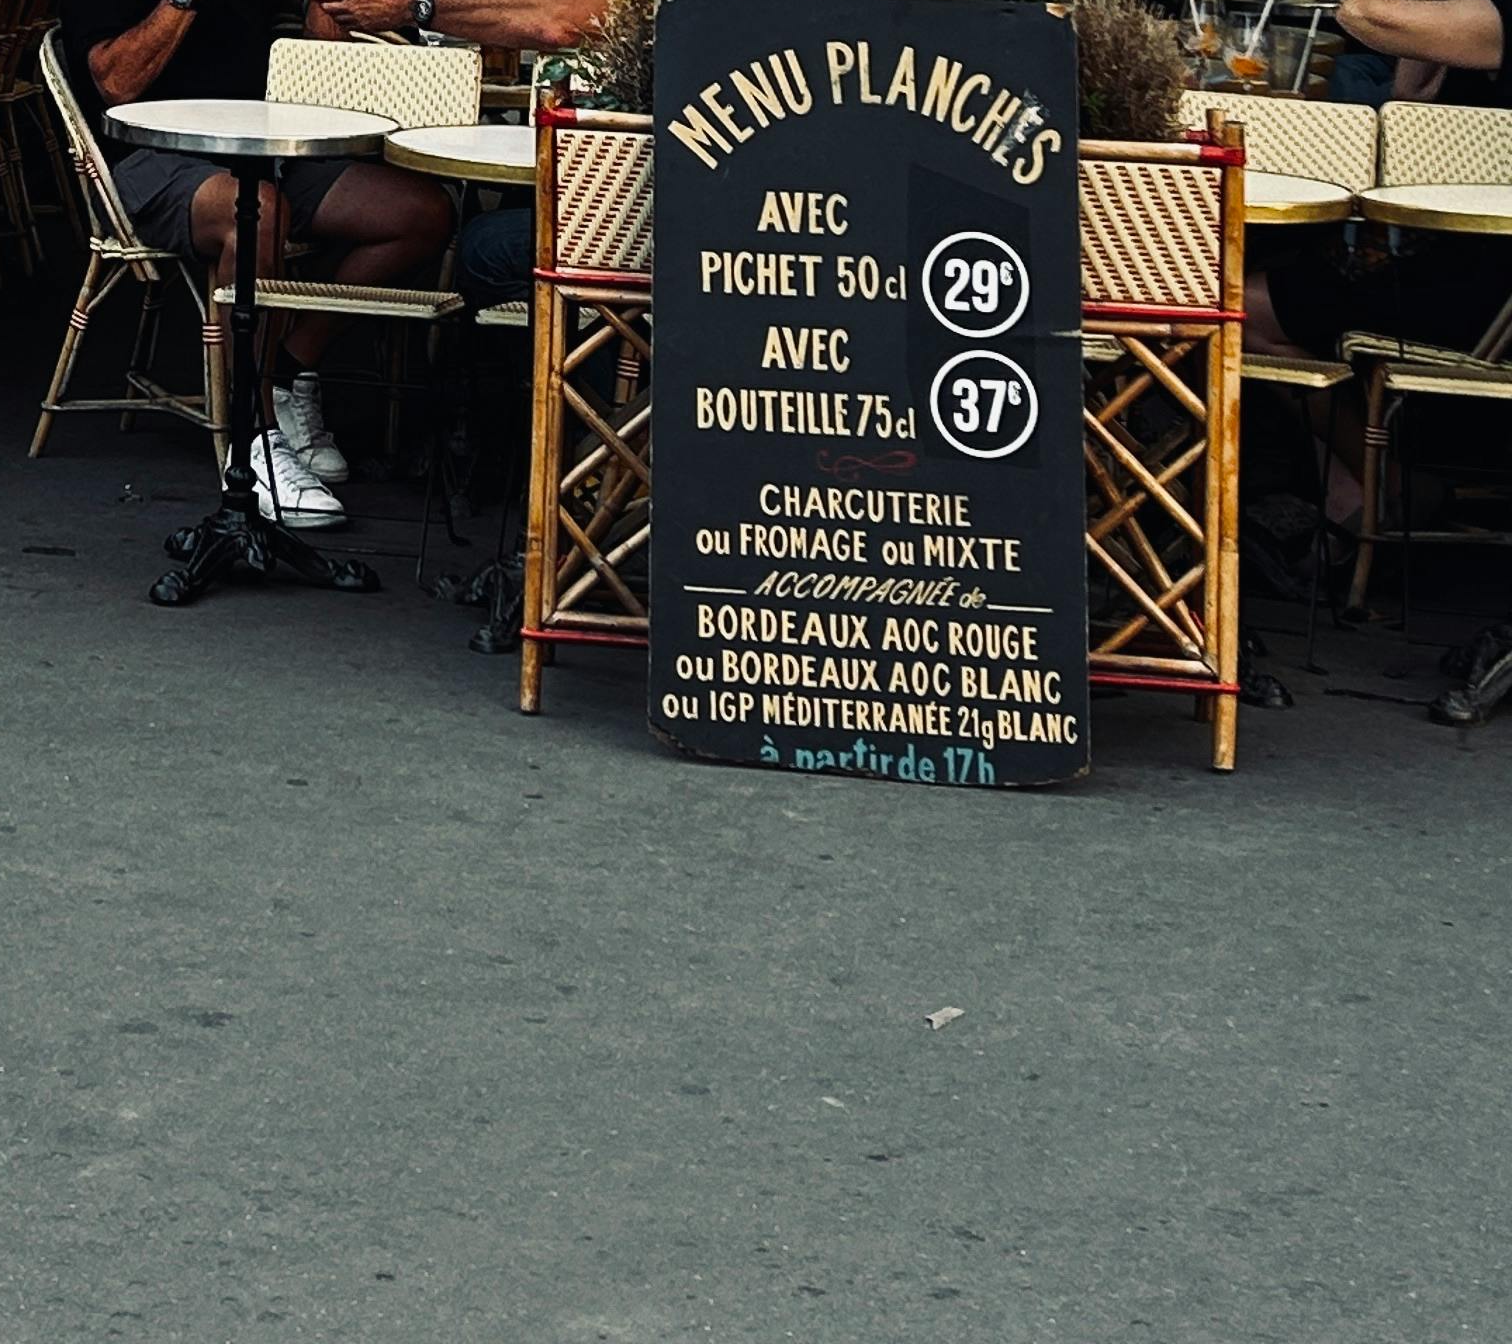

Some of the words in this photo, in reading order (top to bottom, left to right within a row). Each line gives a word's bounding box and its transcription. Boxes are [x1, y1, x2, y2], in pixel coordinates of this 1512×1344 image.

[667, 48, 813, 171] MENU
[826, 40, 1062, 186] PLANCHES
[756, 190, 850, 236] AVEC
[699, 250, 823, 298] PICHET
[760, 325, 851, 374] AVEC
[696, 386, 850, 438] BOUTEILLE
[758, 482, 972, 528] CHARCUTERIE
[695, 527, 731, 556] ou
[738, 523, 869, 564] FROMAGE
[881, 539, 915, 567] ou
[922, 534, 1022, 573] MIXTE
[753, 569, 961, 607] ACCOMPAGNÉE
[958, 585, 987, 609] de
[697, 604, 872, 651] BORDEAUX
[881, 617, 940, 656] AOC
[948, 621, 1040, 661] ROUGE
[675, 653, 715, 682] ou
[721, 648, 883, 694] BORDEAUX
[888, 661, 952, 698] AOC
[960, 665, 1063, 706] BLANC
[661, 692, 700, 721] ou
[708, 689, 756, 724] IGP
[761, 689, 954, 738] MÉDITERRANÉE
[759, 733, 780, 764] à
[896, 742, 937, 784] de
[943, 746, 997, 787] 17h
